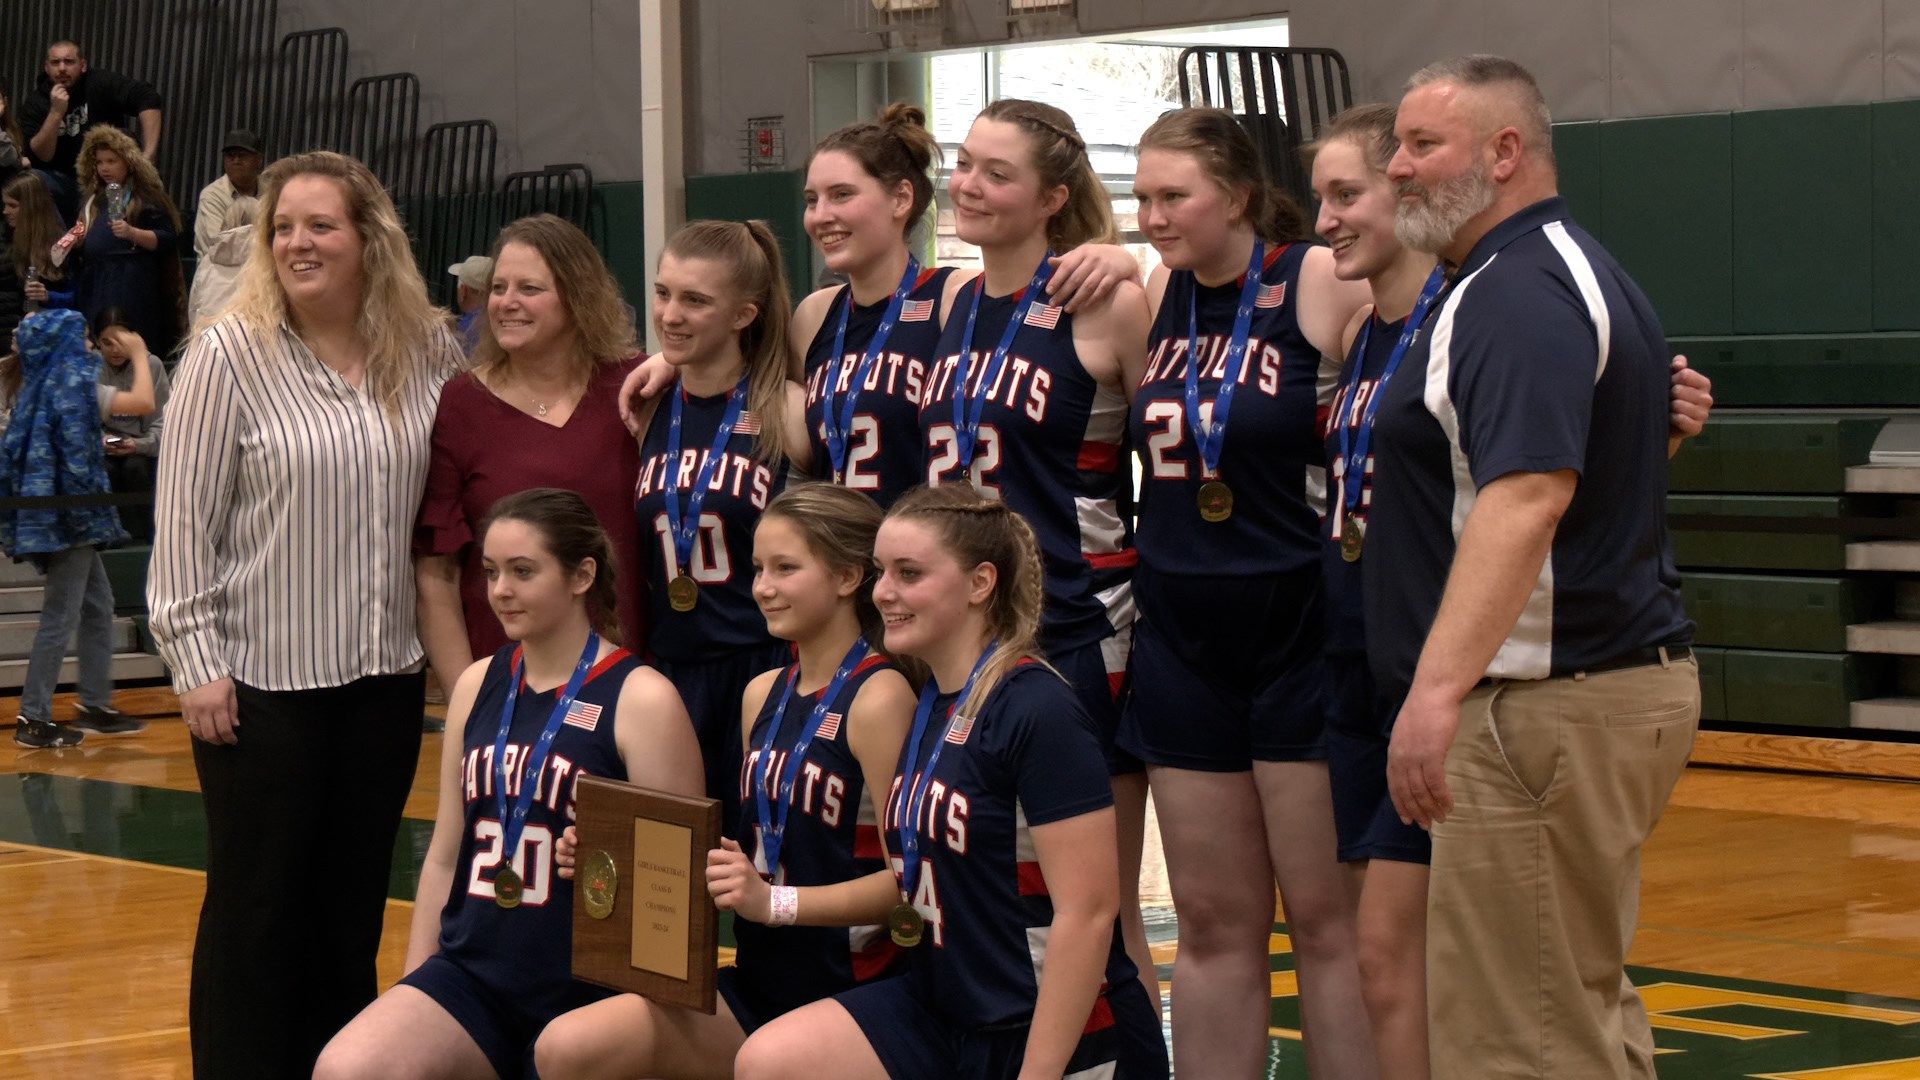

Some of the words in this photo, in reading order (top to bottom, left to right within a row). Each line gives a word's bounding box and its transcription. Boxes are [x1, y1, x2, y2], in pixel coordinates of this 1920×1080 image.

[927, 422, 1000, 500] 22
[1144, 399, 1222, 481] 21
[652, 511, 733, 586] 10
[467, 817, 554, 907] 20
[650, 883, 667, 893] CLASS
